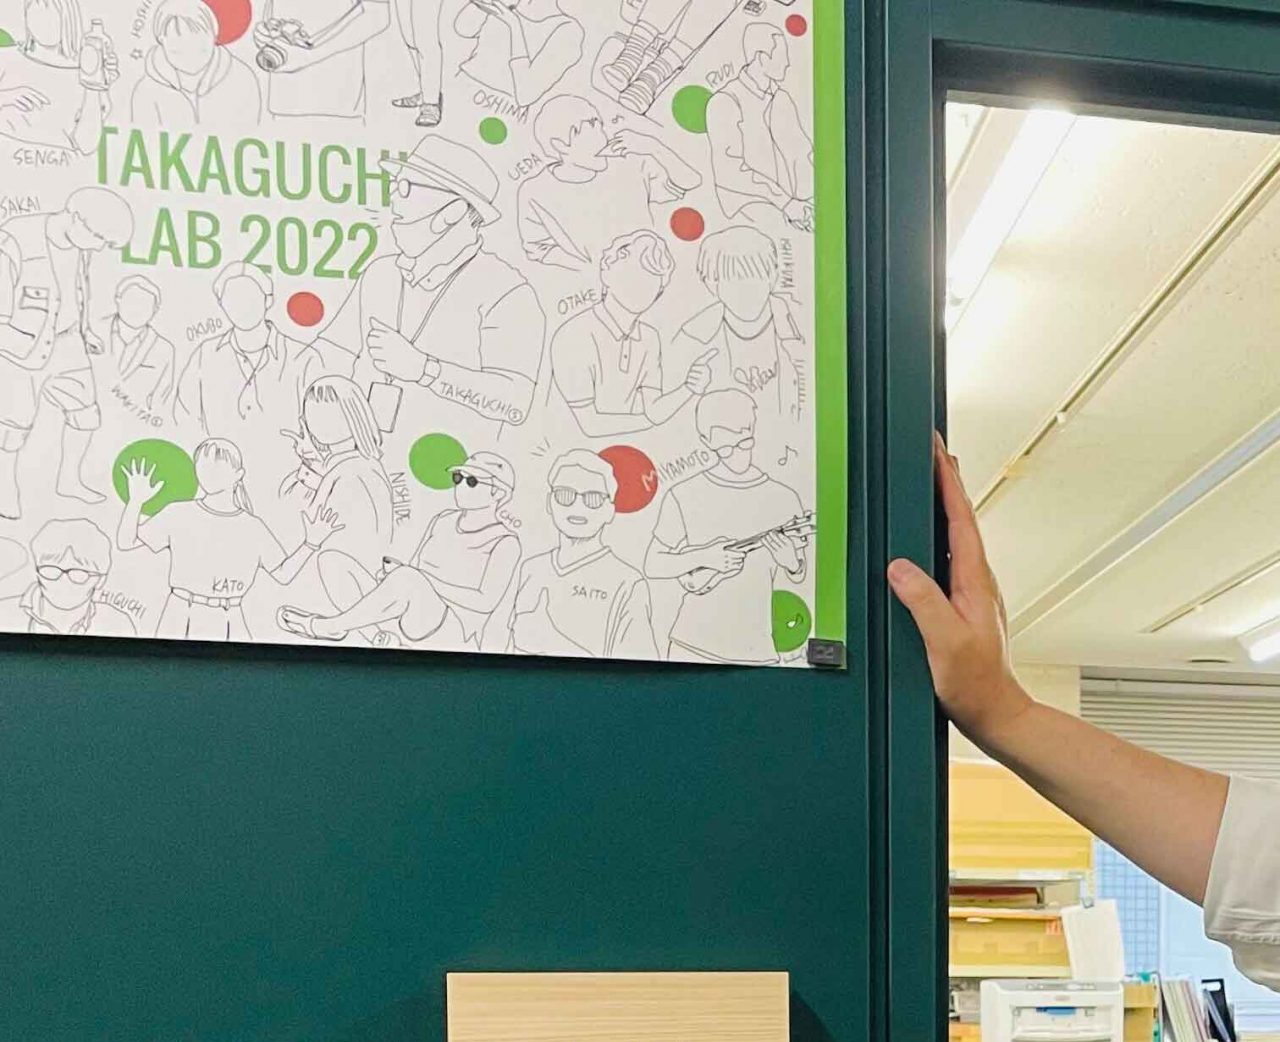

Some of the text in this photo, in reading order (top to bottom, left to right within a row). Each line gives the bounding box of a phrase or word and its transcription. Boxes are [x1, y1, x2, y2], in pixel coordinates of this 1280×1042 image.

[13, 148, 69, 167] SENGA
[96, 126, 408, 207] TAKAGUCH
[508, 153, 542, 180] UEDA
[121, 206, 379, 281] LAB 2022
[557, 289, 599, 315] OTAKE
[641, 449, 709, 492] MIYAMOTO
[212, 576, 244, 594] KATO
[572, 585, 608, 600] SAITO
